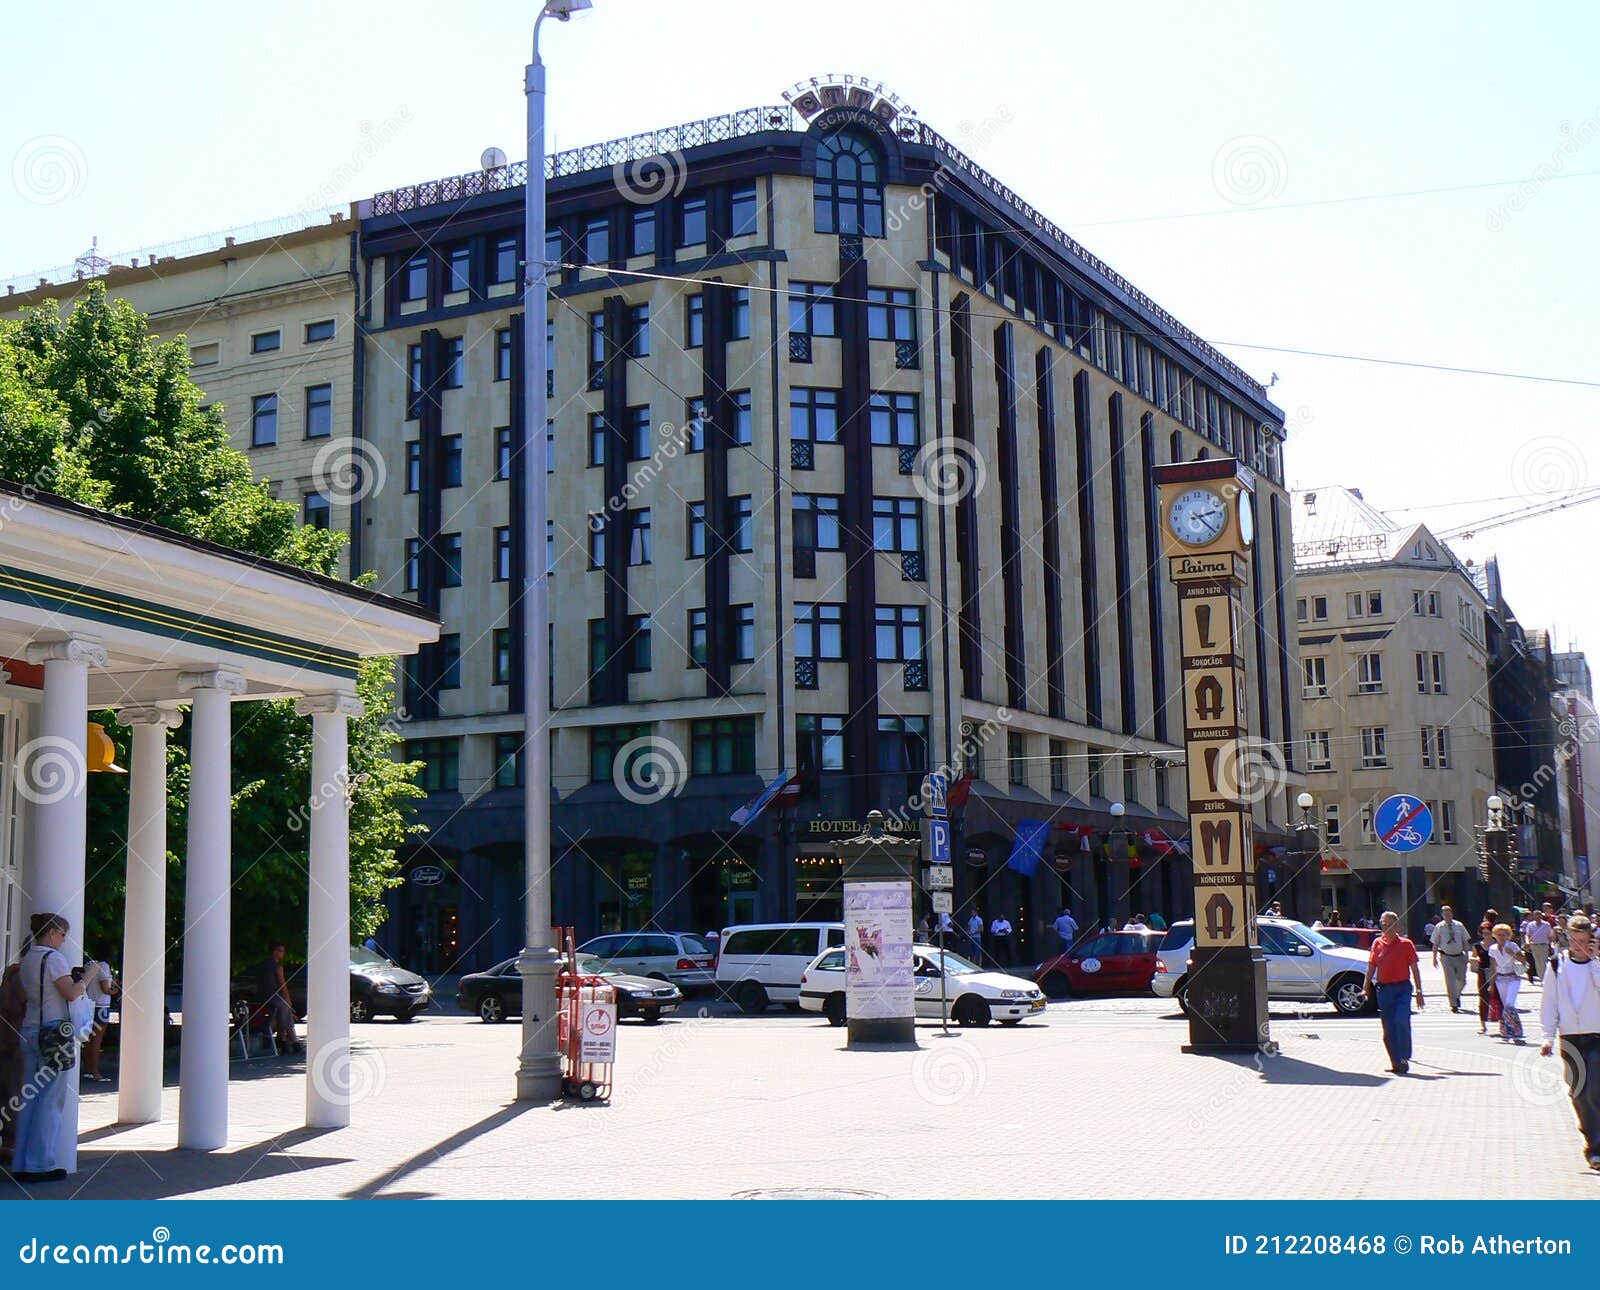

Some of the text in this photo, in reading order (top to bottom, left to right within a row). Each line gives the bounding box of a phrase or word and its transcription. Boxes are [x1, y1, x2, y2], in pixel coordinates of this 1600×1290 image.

[817, 110, 888, 136] SCHWARZ
[1176, 558, 1228, 575] Laima
[1192, 730, 1229, 738] KARAMELES
[809, 820, 861, 833] HOTEL
[934, 826, 946, 857] P
[1200, 820, 1232, 866] M
[1200, 875, 1236, 884] KONFEKTES
